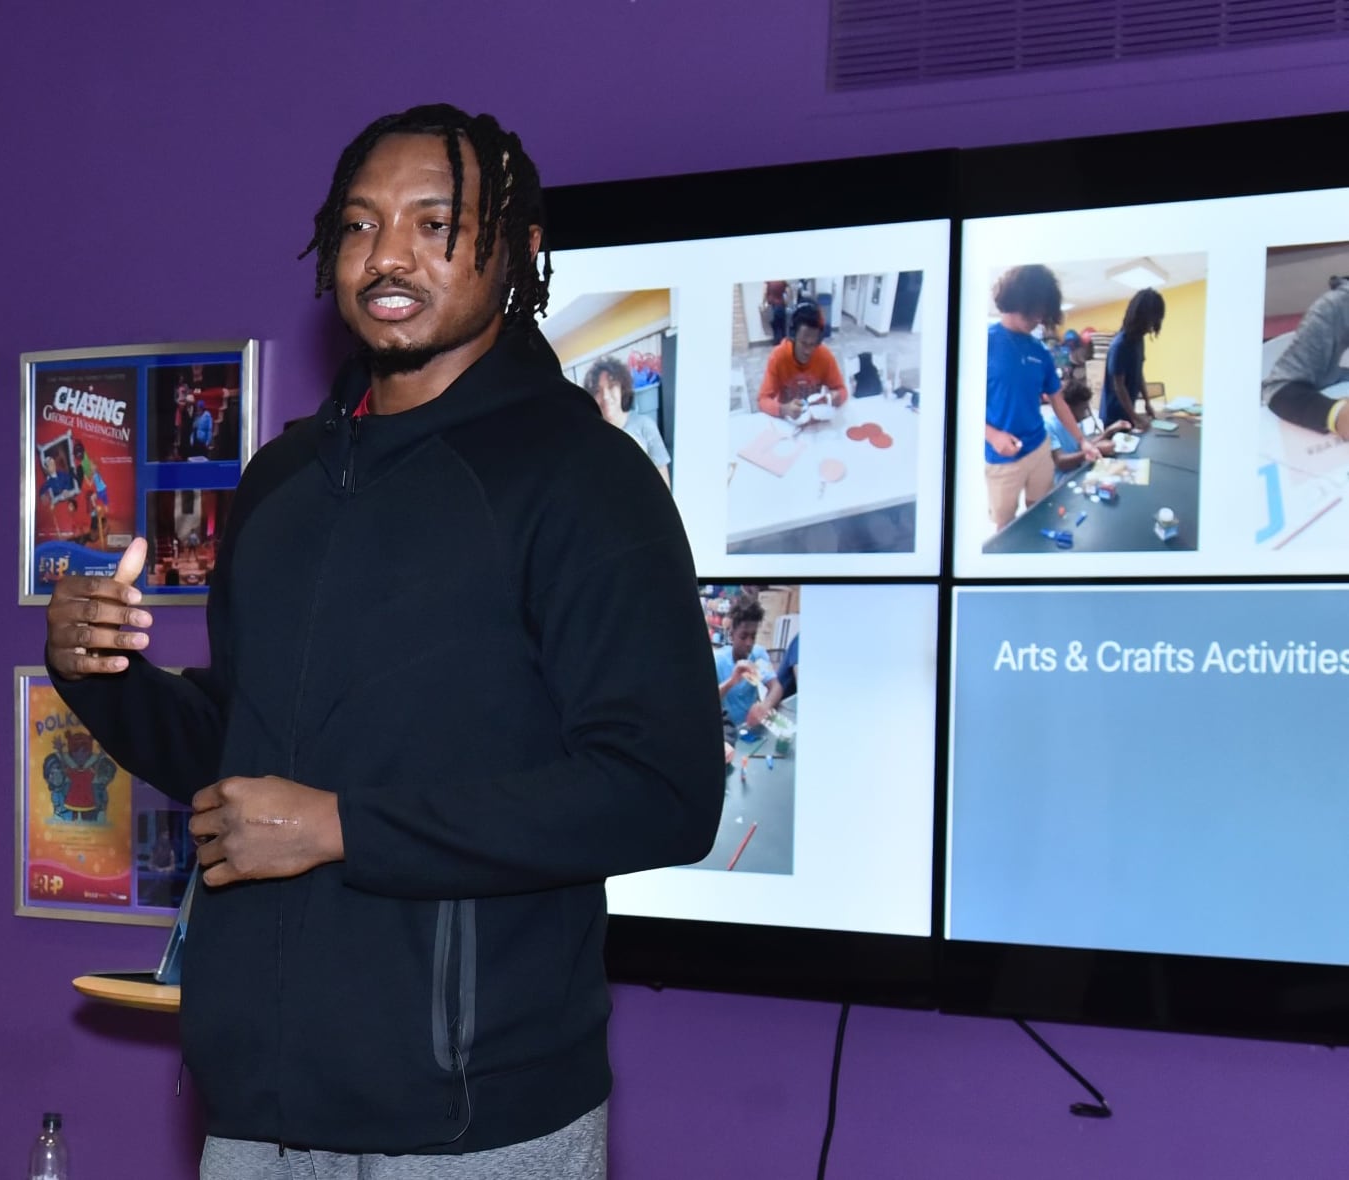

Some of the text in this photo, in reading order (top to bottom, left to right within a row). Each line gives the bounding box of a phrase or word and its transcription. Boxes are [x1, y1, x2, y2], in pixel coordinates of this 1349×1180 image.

[42, 405, 76, 428] GEORGE
[76, 416, 131, 442] WASHINGTON
[55, 385, 127, 426] CHASING
[994, 641, 1057, 673] Arts
[1065, 641, 1089, 673] &
[1096, 640, 1194, 675] Crafts
[35, 711, 83, 737] POLK
